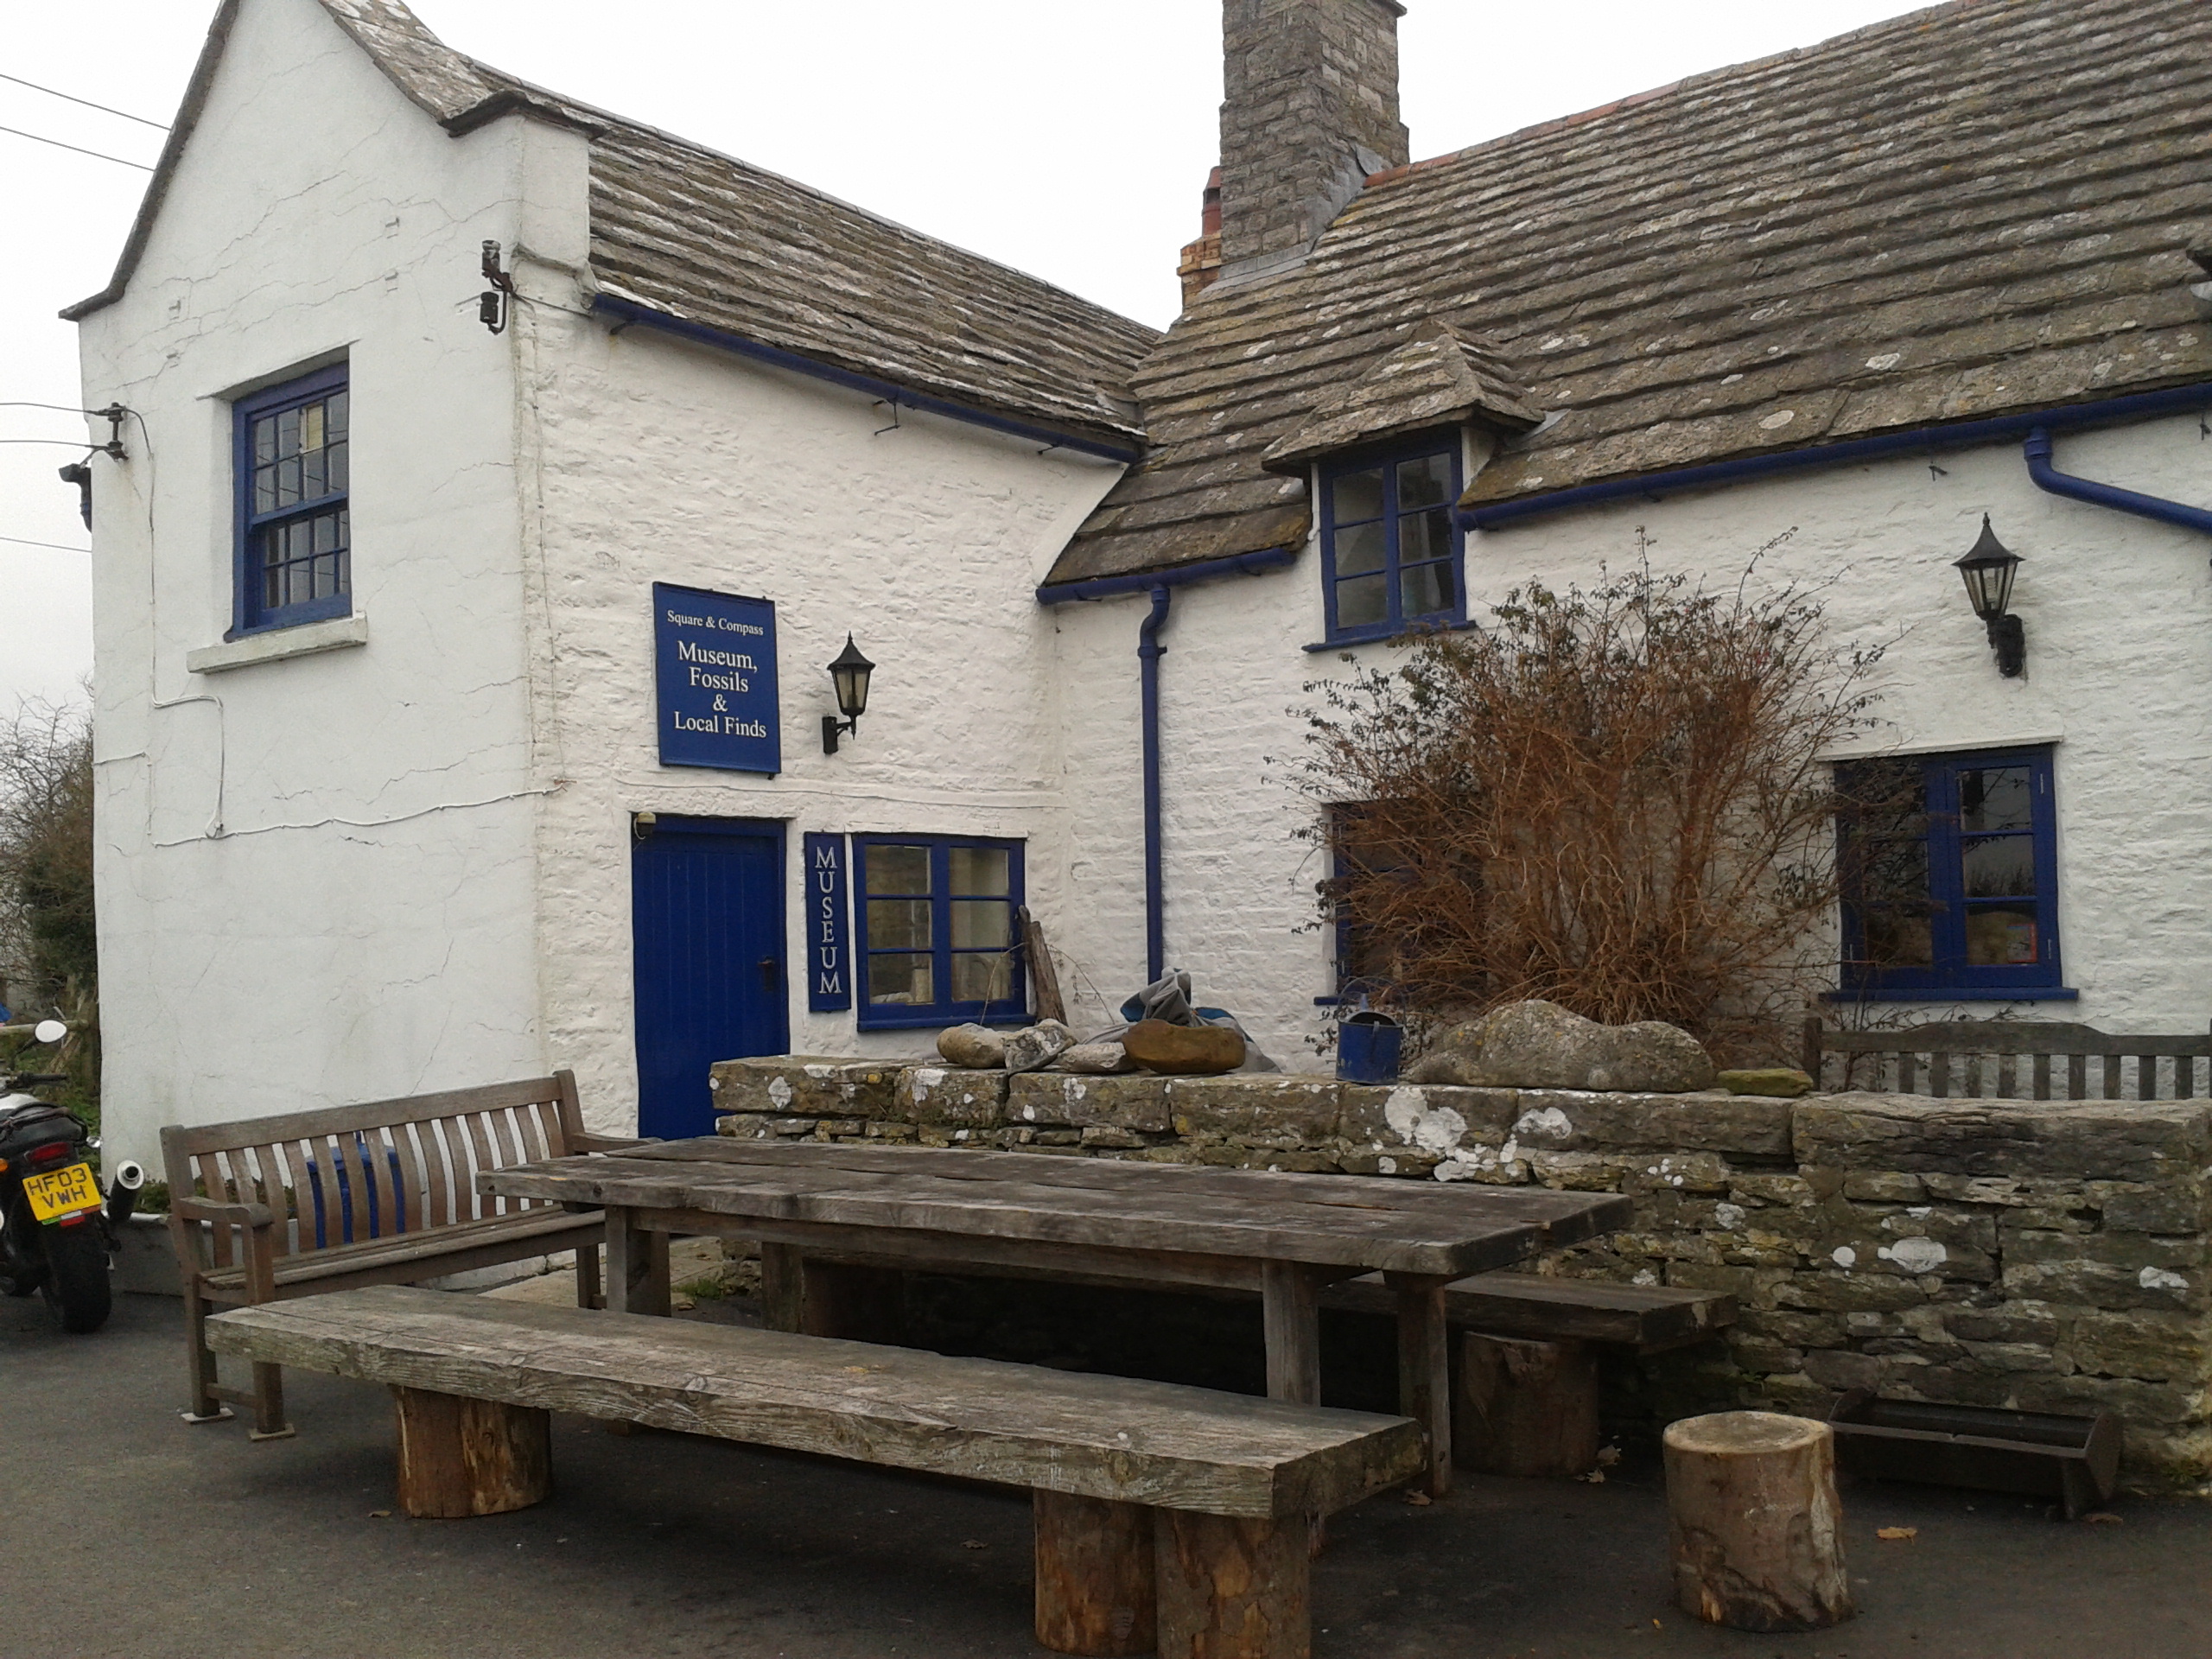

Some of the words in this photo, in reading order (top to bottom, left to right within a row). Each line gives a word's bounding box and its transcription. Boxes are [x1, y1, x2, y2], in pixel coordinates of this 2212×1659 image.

[667, 610, 703, 626] Square
[705, 616, 715, 629] &
[718, 618, 764, 636] Compass
[677, 640, 758, 673] Museum,
[689, 666, 749, 692] Fossils
[713, 694, 728, 712] &
[674, 711, 719, 734] Local
[724, 716, 766, 738] Finds
[815, 846, 842, 994] MUSEUM
[28, 1167, 87, 1196] HF03
[41, 1185, 87, 1209] VWH
